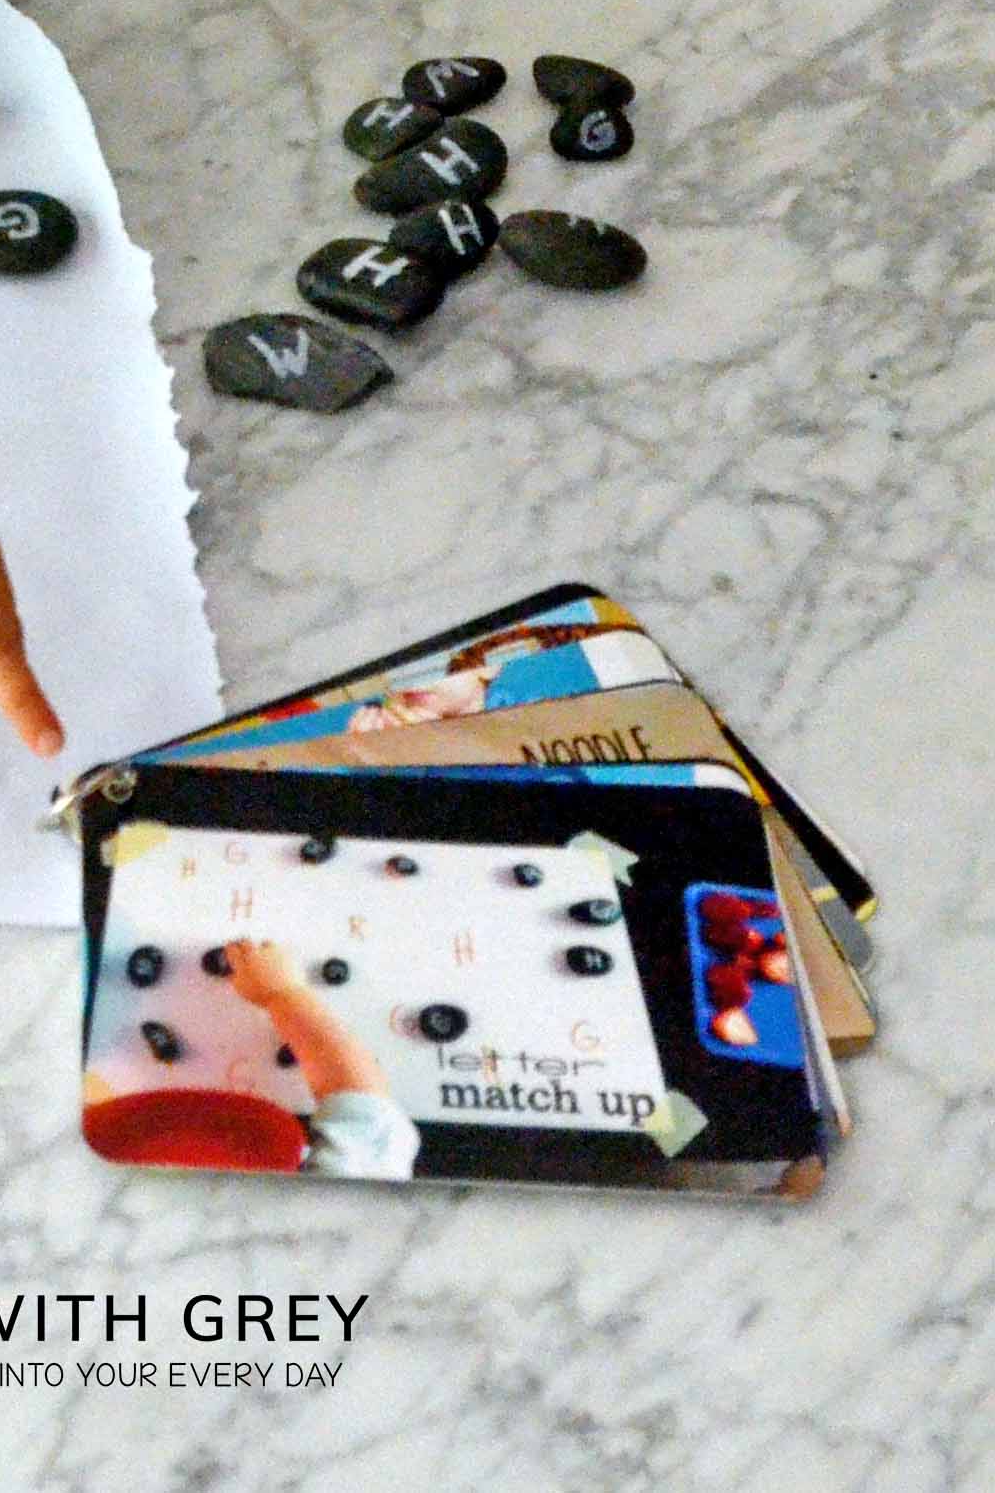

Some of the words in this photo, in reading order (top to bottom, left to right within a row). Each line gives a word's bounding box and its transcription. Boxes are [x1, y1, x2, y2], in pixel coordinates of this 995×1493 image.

[362, 102, 414, 129] H
[420, 136, 480, 186] H
[437, 203, 485, 256] H
[342, 244, 410, 287] H
[247, 329, 312, 380] W
[438, 1046, 605, 1076] letter
[441, 1080, 581, 1115] match
[598, 1090, 655, 1126] up
